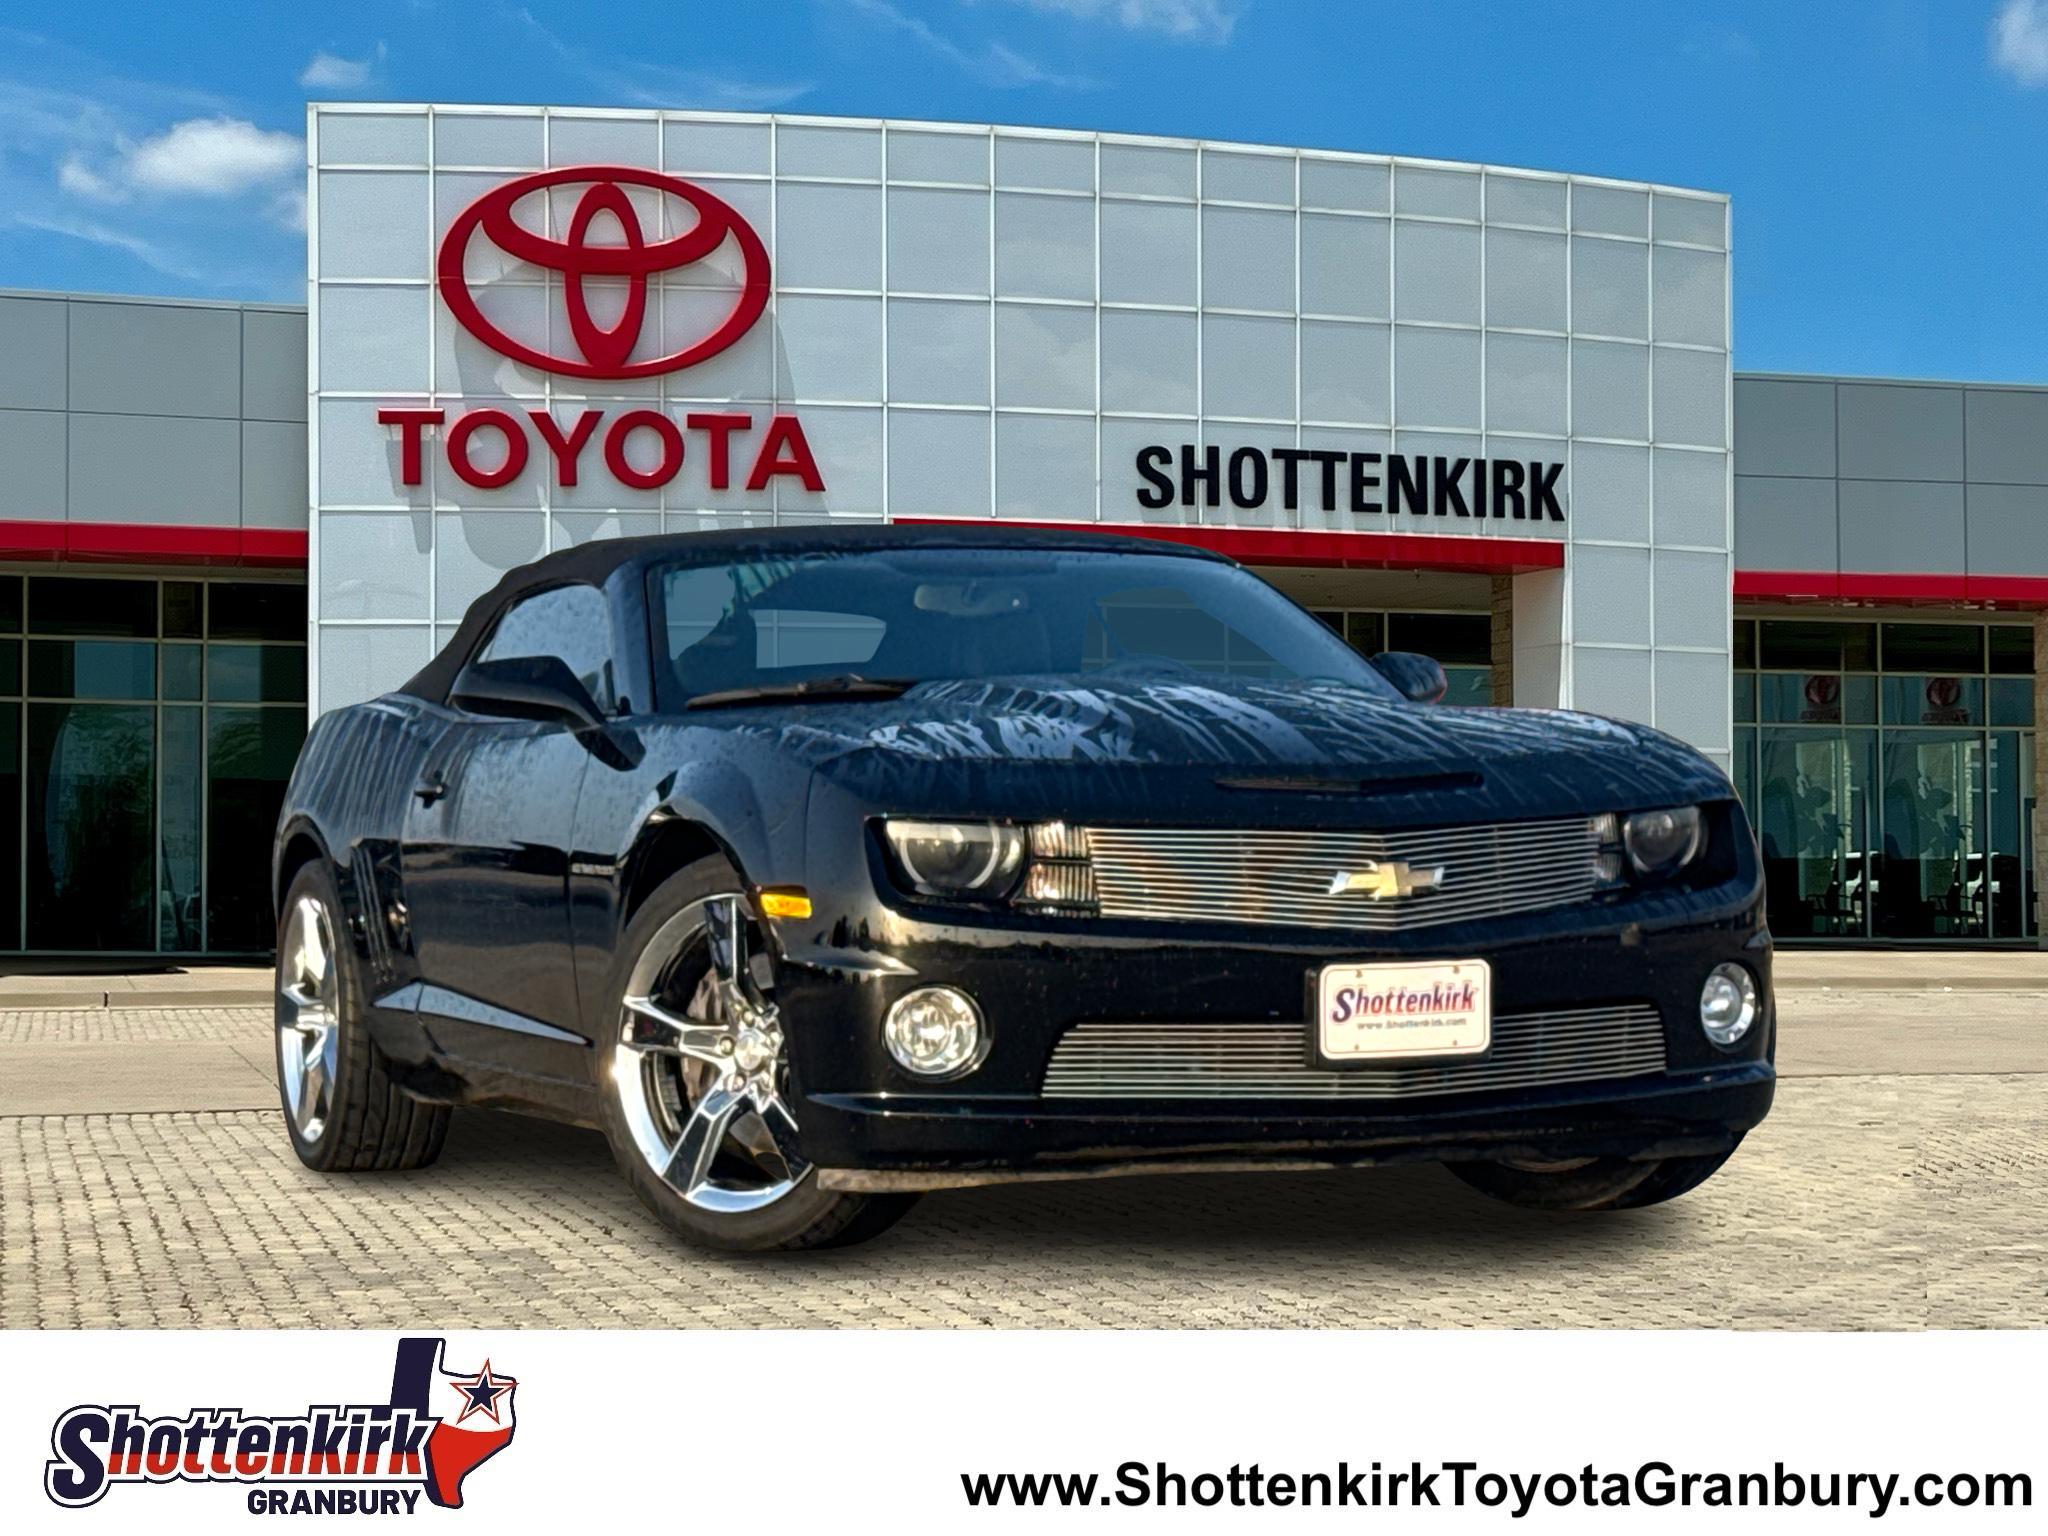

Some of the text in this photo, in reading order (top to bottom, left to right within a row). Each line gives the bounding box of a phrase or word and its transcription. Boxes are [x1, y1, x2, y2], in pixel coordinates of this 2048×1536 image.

[378, 405, 826, 493] TOYOTA
[1135, 444, 1566, 523] SHOTTENKIRK
[1331, 981, 1475, 1023] Shottenkirk
